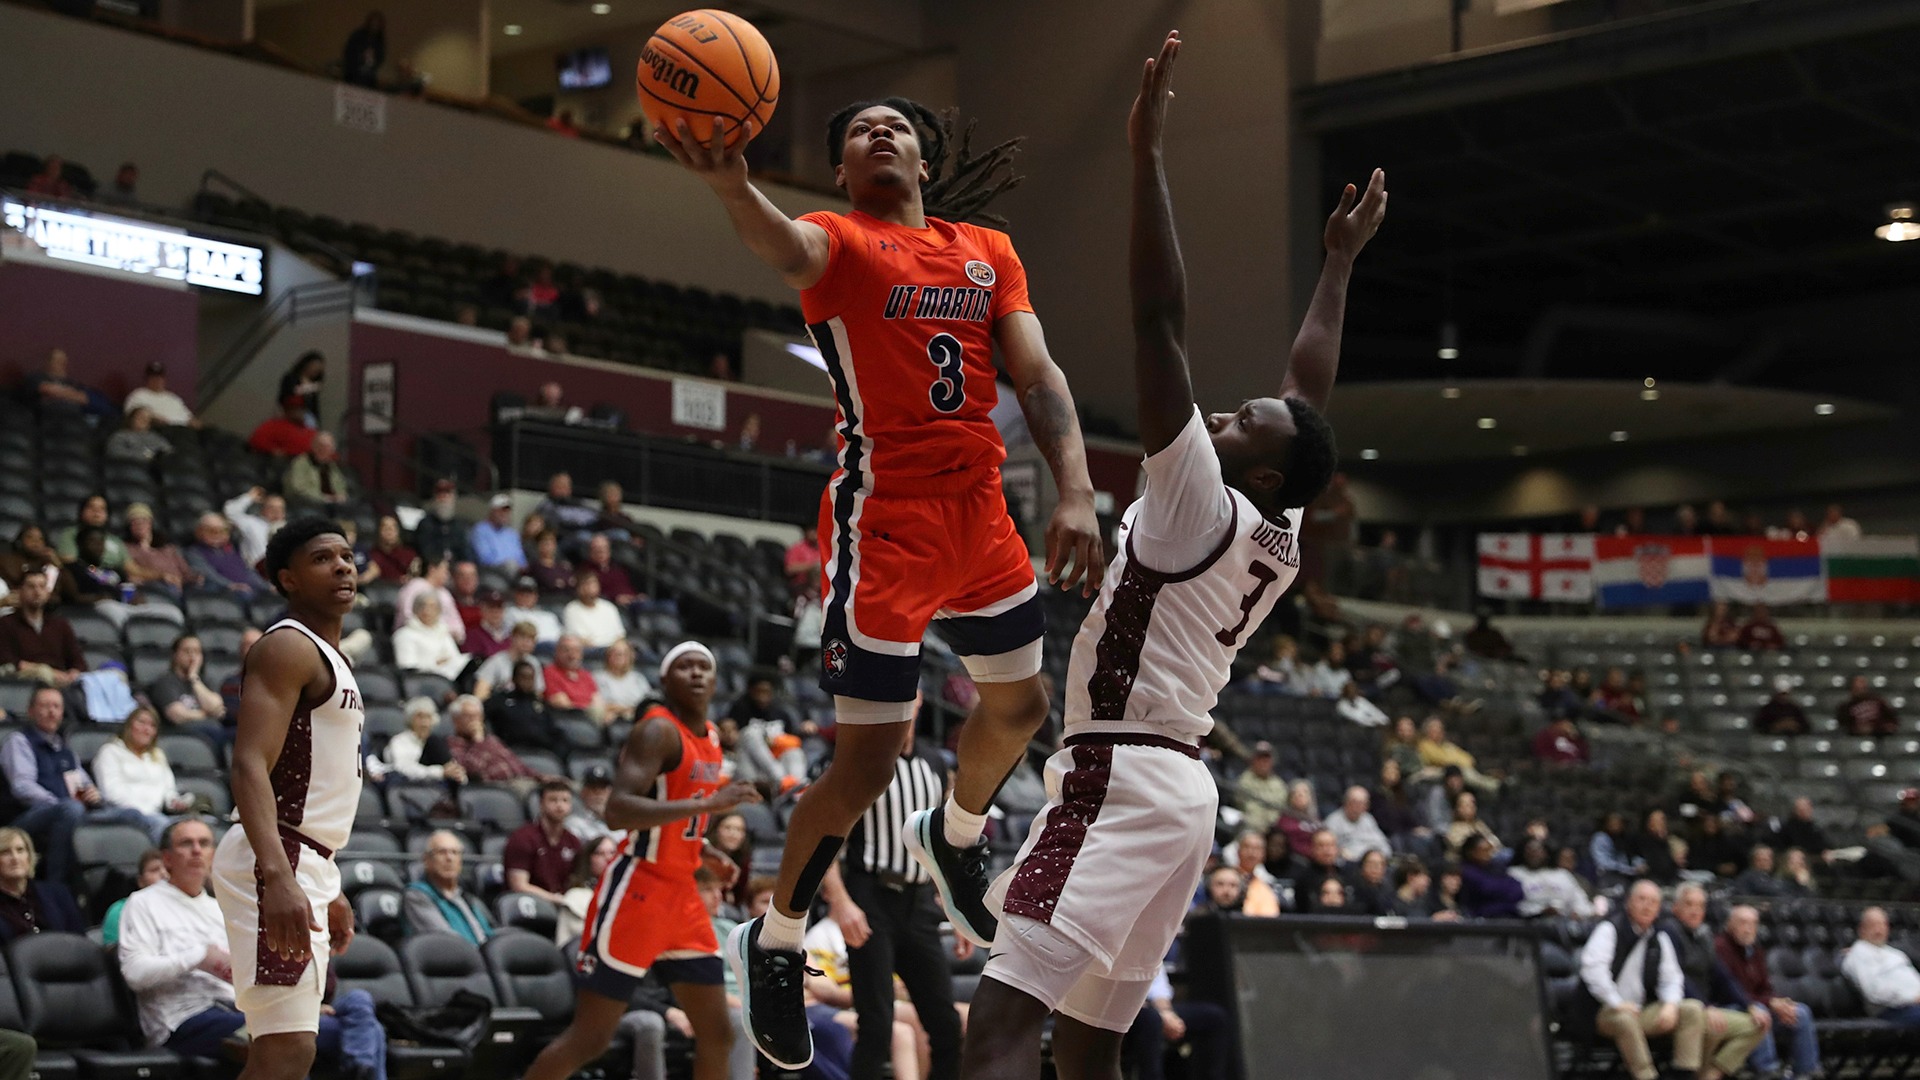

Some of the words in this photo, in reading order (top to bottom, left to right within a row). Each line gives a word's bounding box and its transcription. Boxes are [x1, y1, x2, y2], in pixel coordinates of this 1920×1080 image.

[640, 45, 699, 99] Wilson
[883, 285, 918, 320] UT
[914, 286, 993, 322] MARTIN
[926, 332, 966, 414] 3
[1215, 559, 1278, 647] 3
